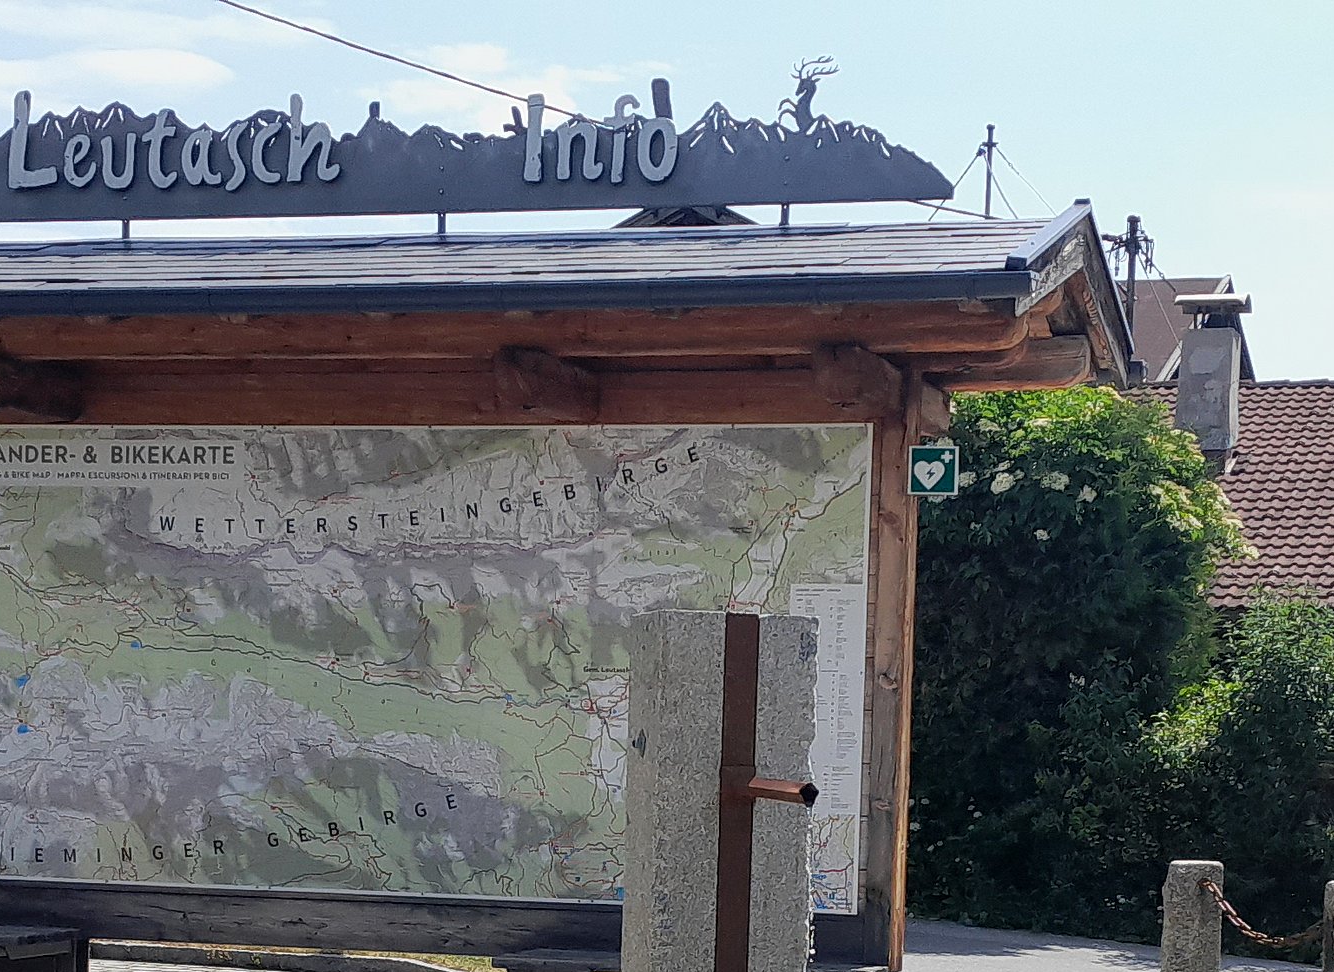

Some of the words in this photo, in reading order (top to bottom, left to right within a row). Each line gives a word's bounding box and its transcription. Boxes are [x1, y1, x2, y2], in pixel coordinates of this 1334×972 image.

[8, 90, 340, 191] Leutasch
[523, 93, 679, 184] Info
[3, 471, 10, 479] &
[11, 471, 30, 479] BIKE
[32, 471, 51, 479] MAP
[56, 471, 86, 479] MAPPA
[88, 471, 140, 480] ESCURSIONI
[141, 472, 147, 480] &
[149, 472, 192, 480] ITINERARI
[193, 472, 210, 480] PER
[212, 472, 230, 480] BICI
[82, 445, 97, 464] &
[110, 445, 235, 465] BIKEKARTE
[160, 445, 701, 534] WETTERSTEINGEBIRGE
[266, 793, 459, 848] GEBIRGE
